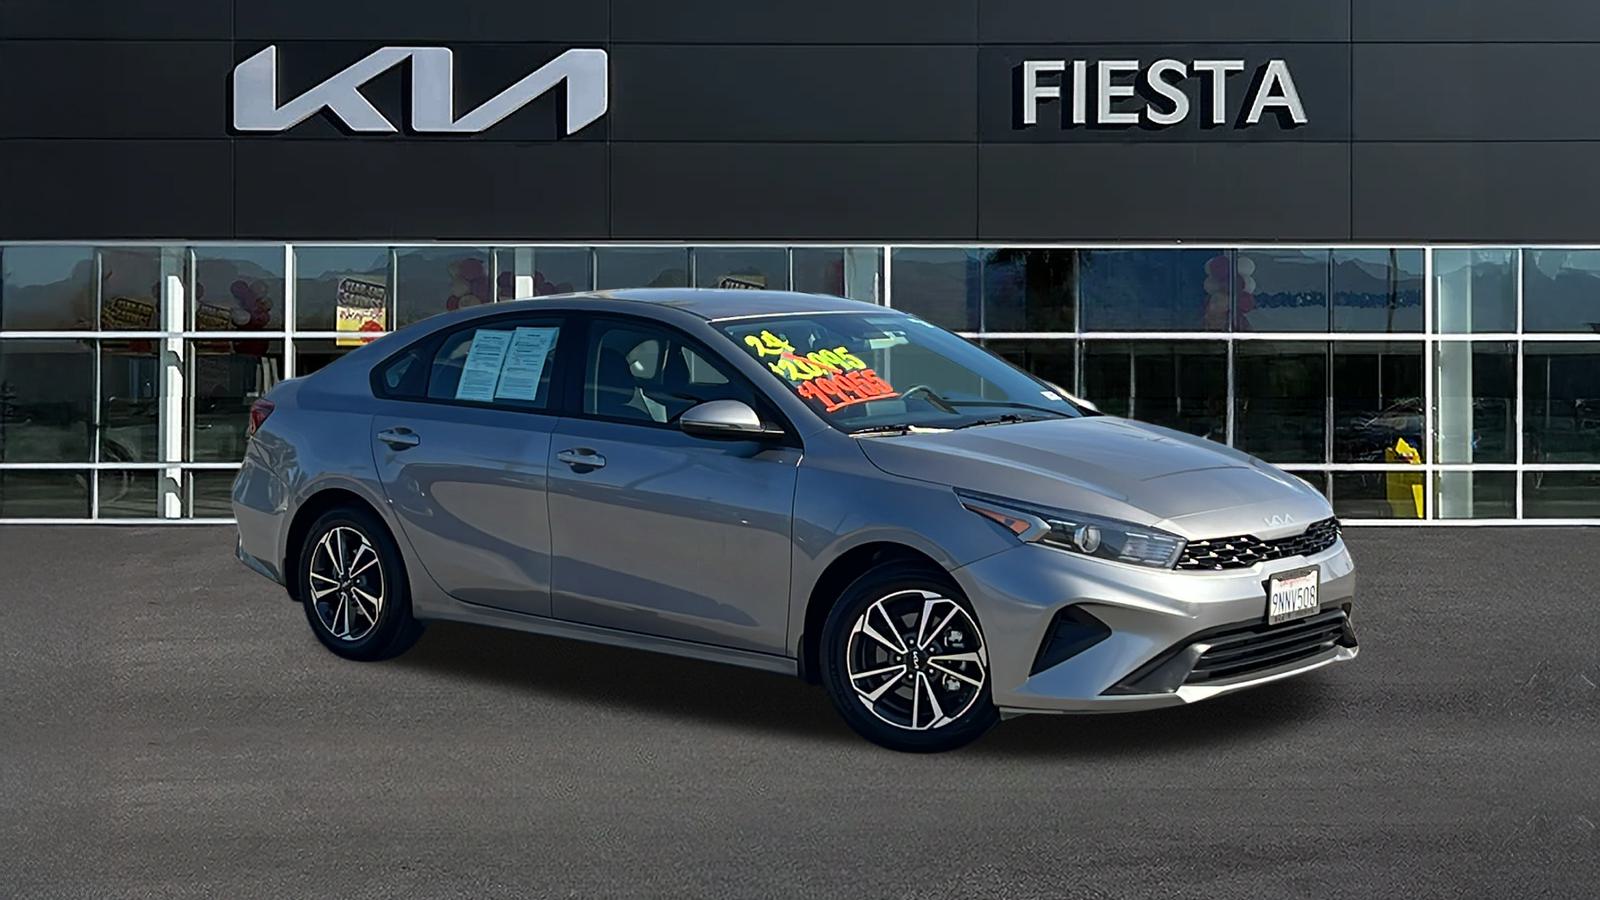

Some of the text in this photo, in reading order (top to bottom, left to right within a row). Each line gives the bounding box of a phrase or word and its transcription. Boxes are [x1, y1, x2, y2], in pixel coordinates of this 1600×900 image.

[233, 44, 608, 136] KIA
[1023, 58, 1308, 125] FIESTA
[744, 330, 796, 357] 24
[1272, 585, 1316, 615] 9NNV508
